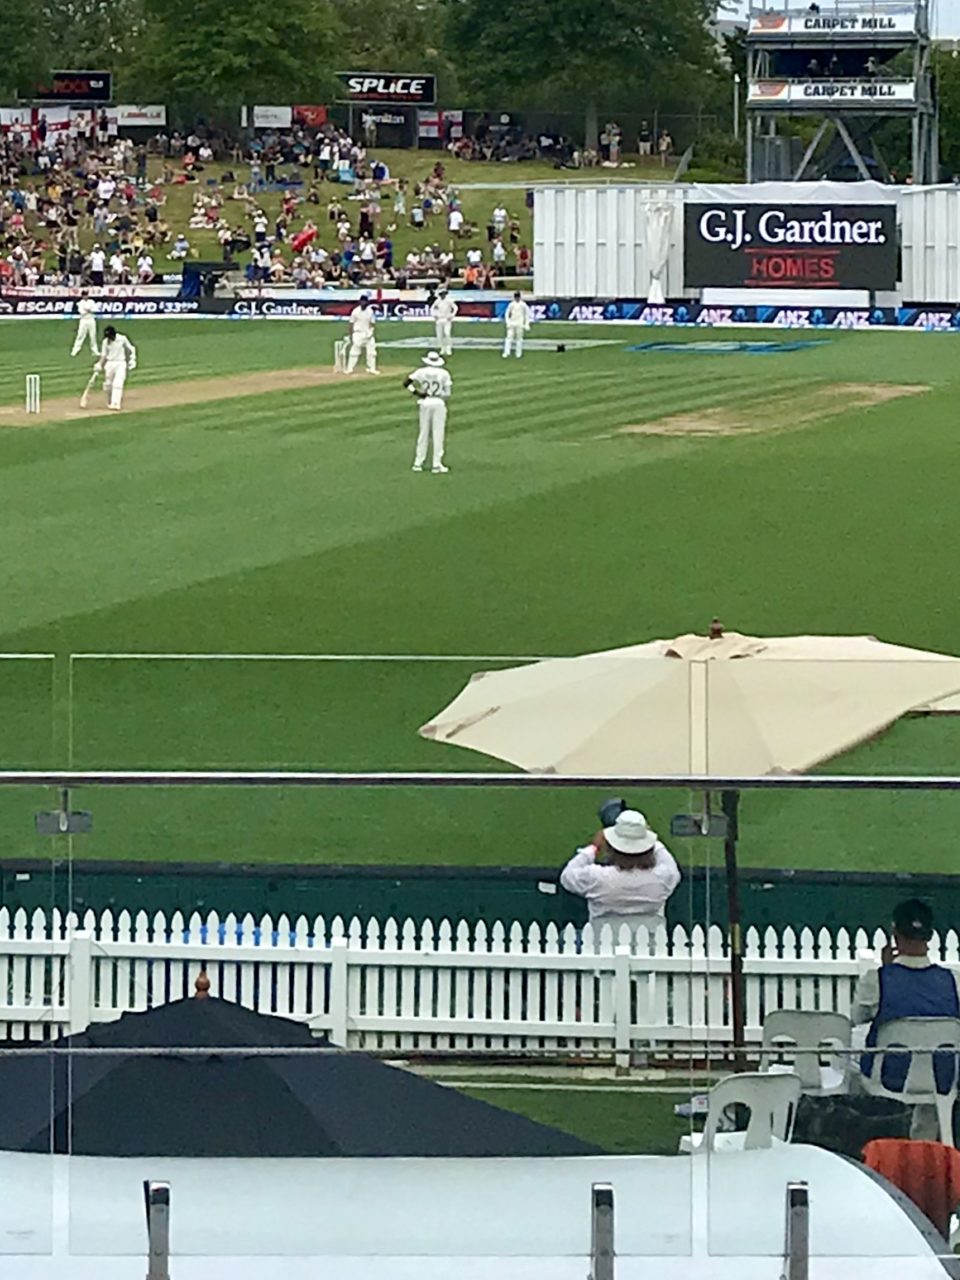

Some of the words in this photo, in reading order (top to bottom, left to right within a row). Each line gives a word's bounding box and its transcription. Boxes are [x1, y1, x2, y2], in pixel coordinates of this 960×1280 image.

[804, 18, 858, 29] CARPET
[861, 18, 895, 29] MILL
[804, 86, 858, 97] CARPET
[861, 86, 895, 97] MILL
[700, 209, 751, 249] G.J.
[759, 210, 886, 244] Gardner.
[752, 258, 834, 278] HOMES
[16, 301, 73, 313] ESCAPE
[76, 301, 122, 313] TEND
[125, 302, 157, 313] FWD
[234, 301, 260, 316] G.J.
[568, 306, 604, 319] ANZ
[639, 308, 674, 322] ANZ
[696, 309, 732, 323] ANZ
[773, 310, 809, 325] ANZ
[832, 311, 870, 326] ANZ
[913, 313, 951, 327] ANZ
[422, 381, 441, 397] 22
